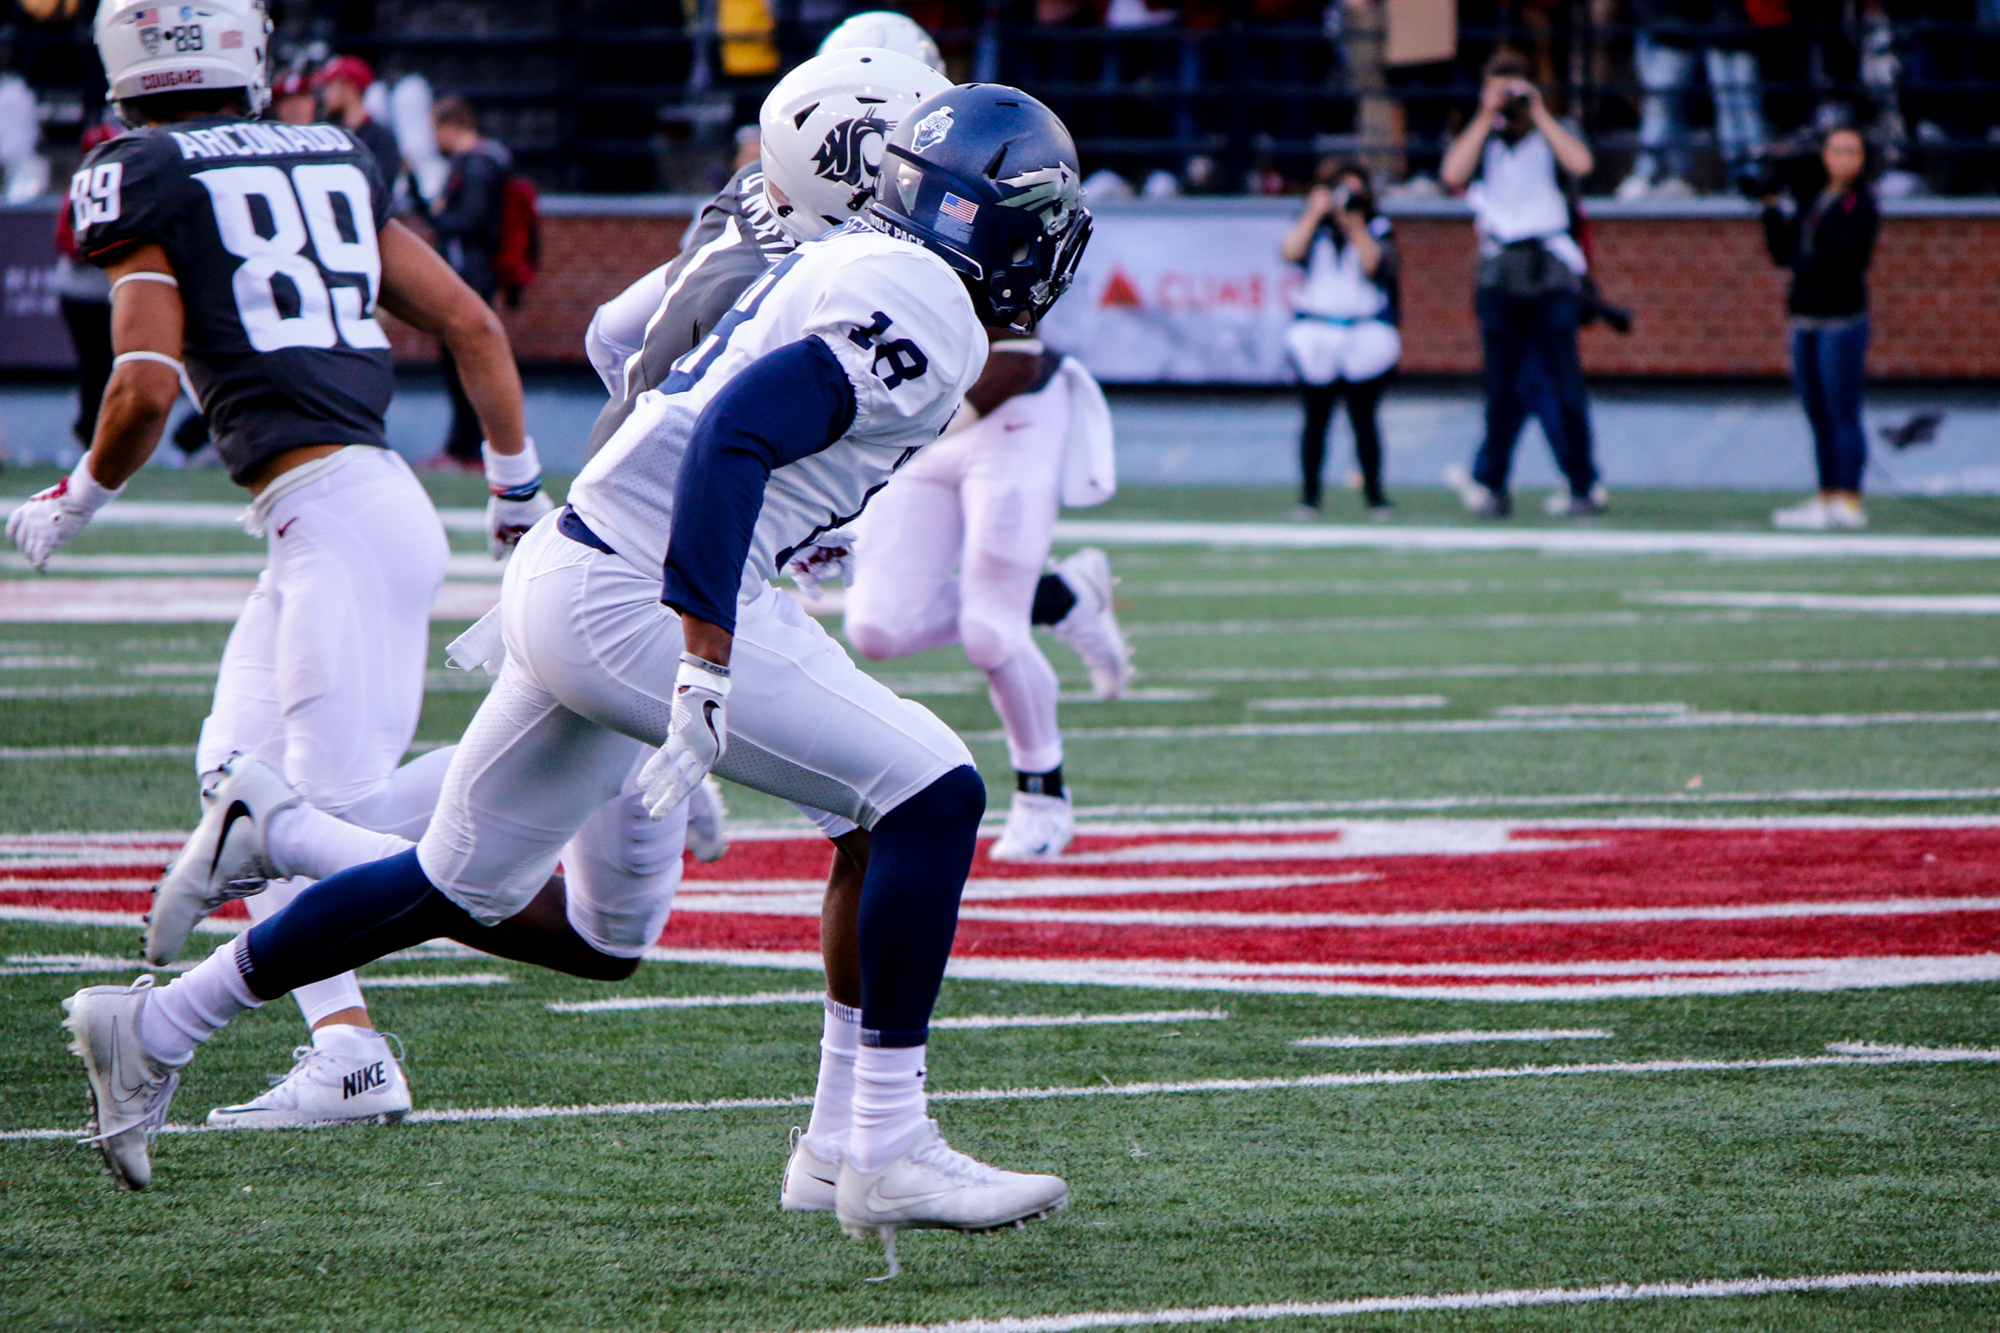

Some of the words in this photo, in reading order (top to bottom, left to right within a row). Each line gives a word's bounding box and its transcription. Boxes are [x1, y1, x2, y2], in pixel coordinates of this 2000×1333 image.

[173, 24, 203, 52] 89
[140, 69, 204, 91] COUGARS
[169, 123, 354, 160] ARCONADO
[69, 162, 123, 232] 89
[189, 163, 392, 353] 89
[848, 311, 929, 391] 18
[342, 1060, 388, 1101] NIKE
